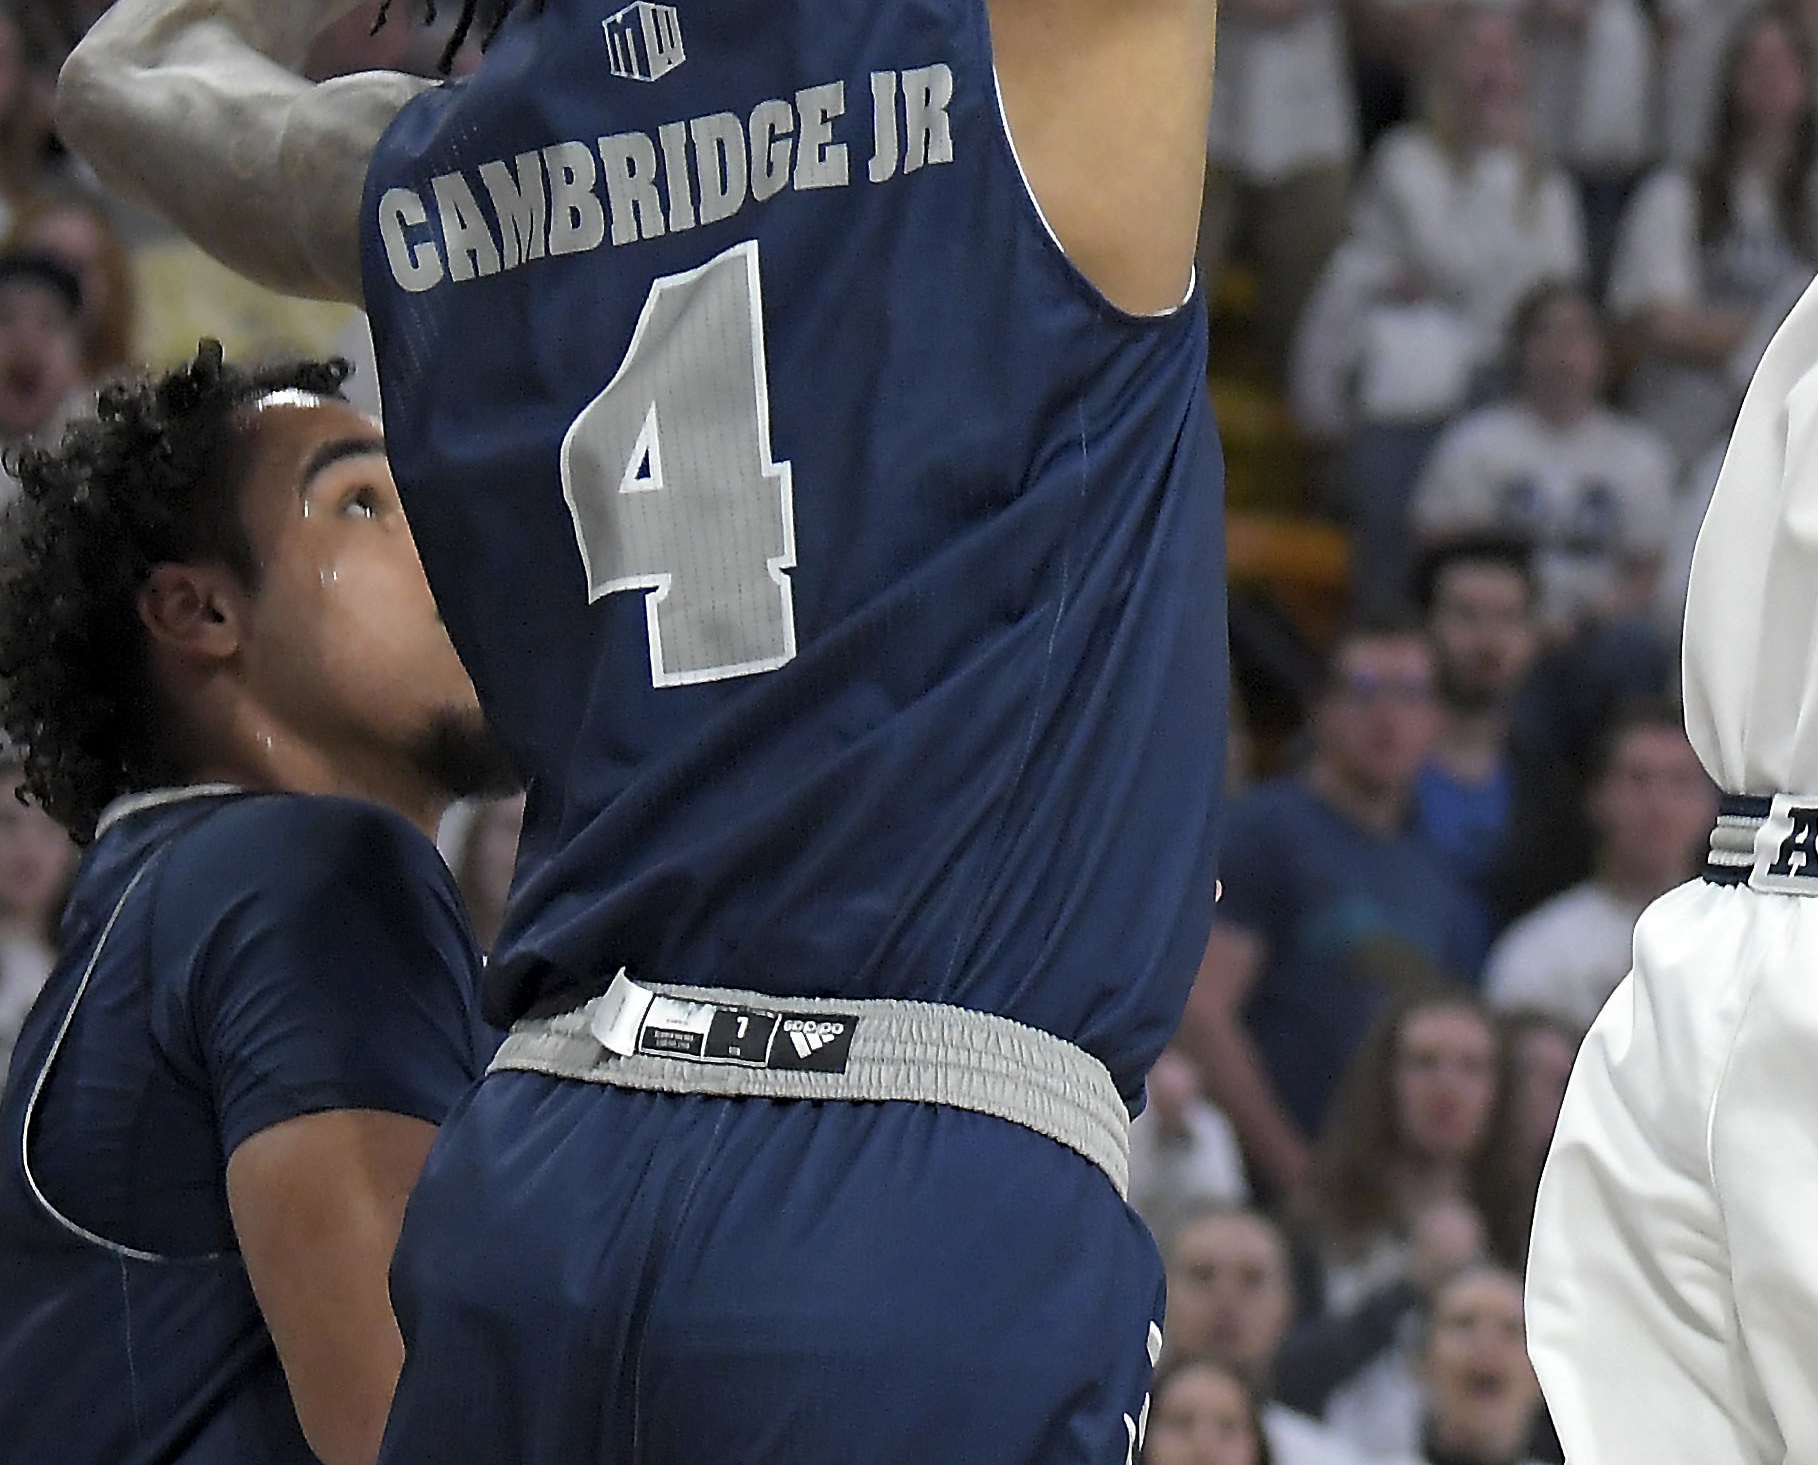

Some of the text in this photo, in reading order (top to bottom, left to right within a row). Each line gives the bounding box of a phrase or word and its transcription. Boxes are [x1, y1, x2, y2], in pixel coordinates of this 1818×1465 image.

[379, 63, 954, 292] CAMBRIDGE JR
[560, 240, 797, 688] 4
